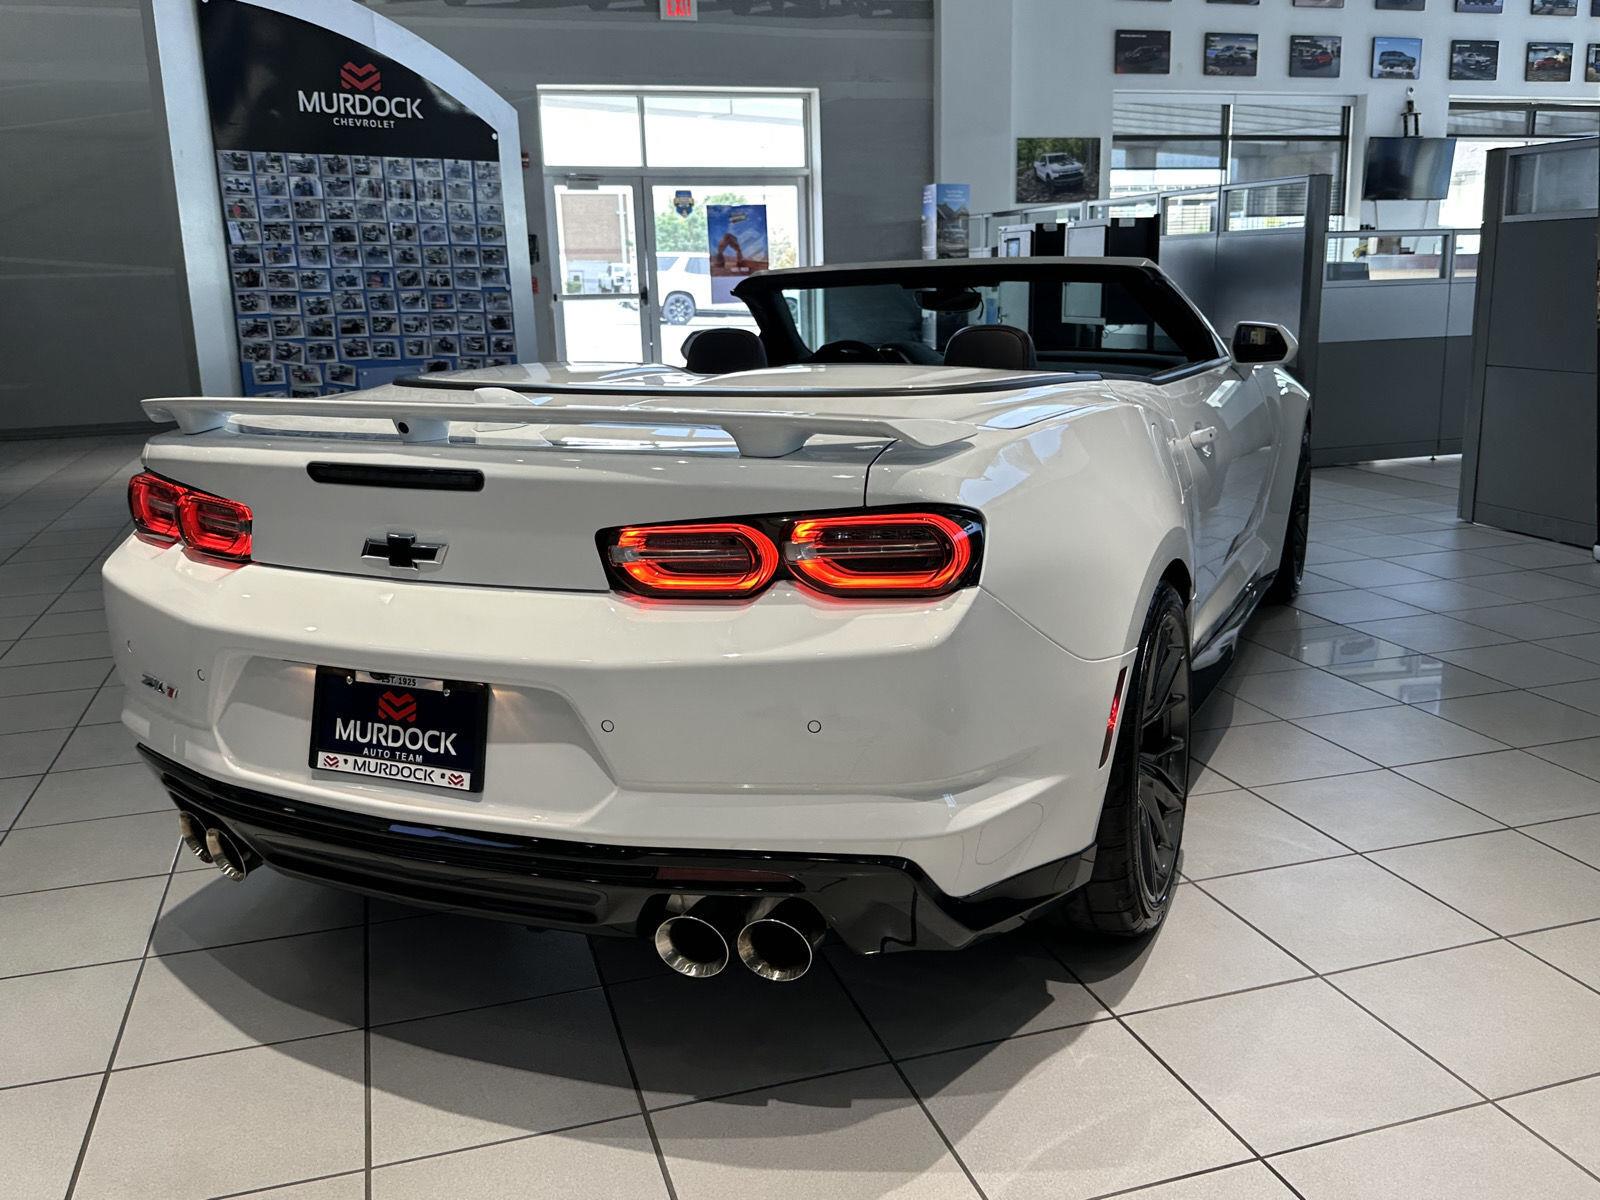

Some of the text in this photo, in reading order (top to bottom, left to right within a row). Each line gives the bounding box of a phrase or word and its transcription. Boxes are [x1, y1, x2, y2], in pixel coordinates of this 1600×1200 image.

[667, 0, 692, 16] EXIT
[298, 90, 424, 120] MURDOCK
[333, 117, 395, 129] CHEVROLET
[398, 677, 417, 687] 1925
[335, 717, 458, 756] MURDOCK
[362, 747, 423, 763] AUTO TEAM
[352, 758, 435, 783] MURDOCK
